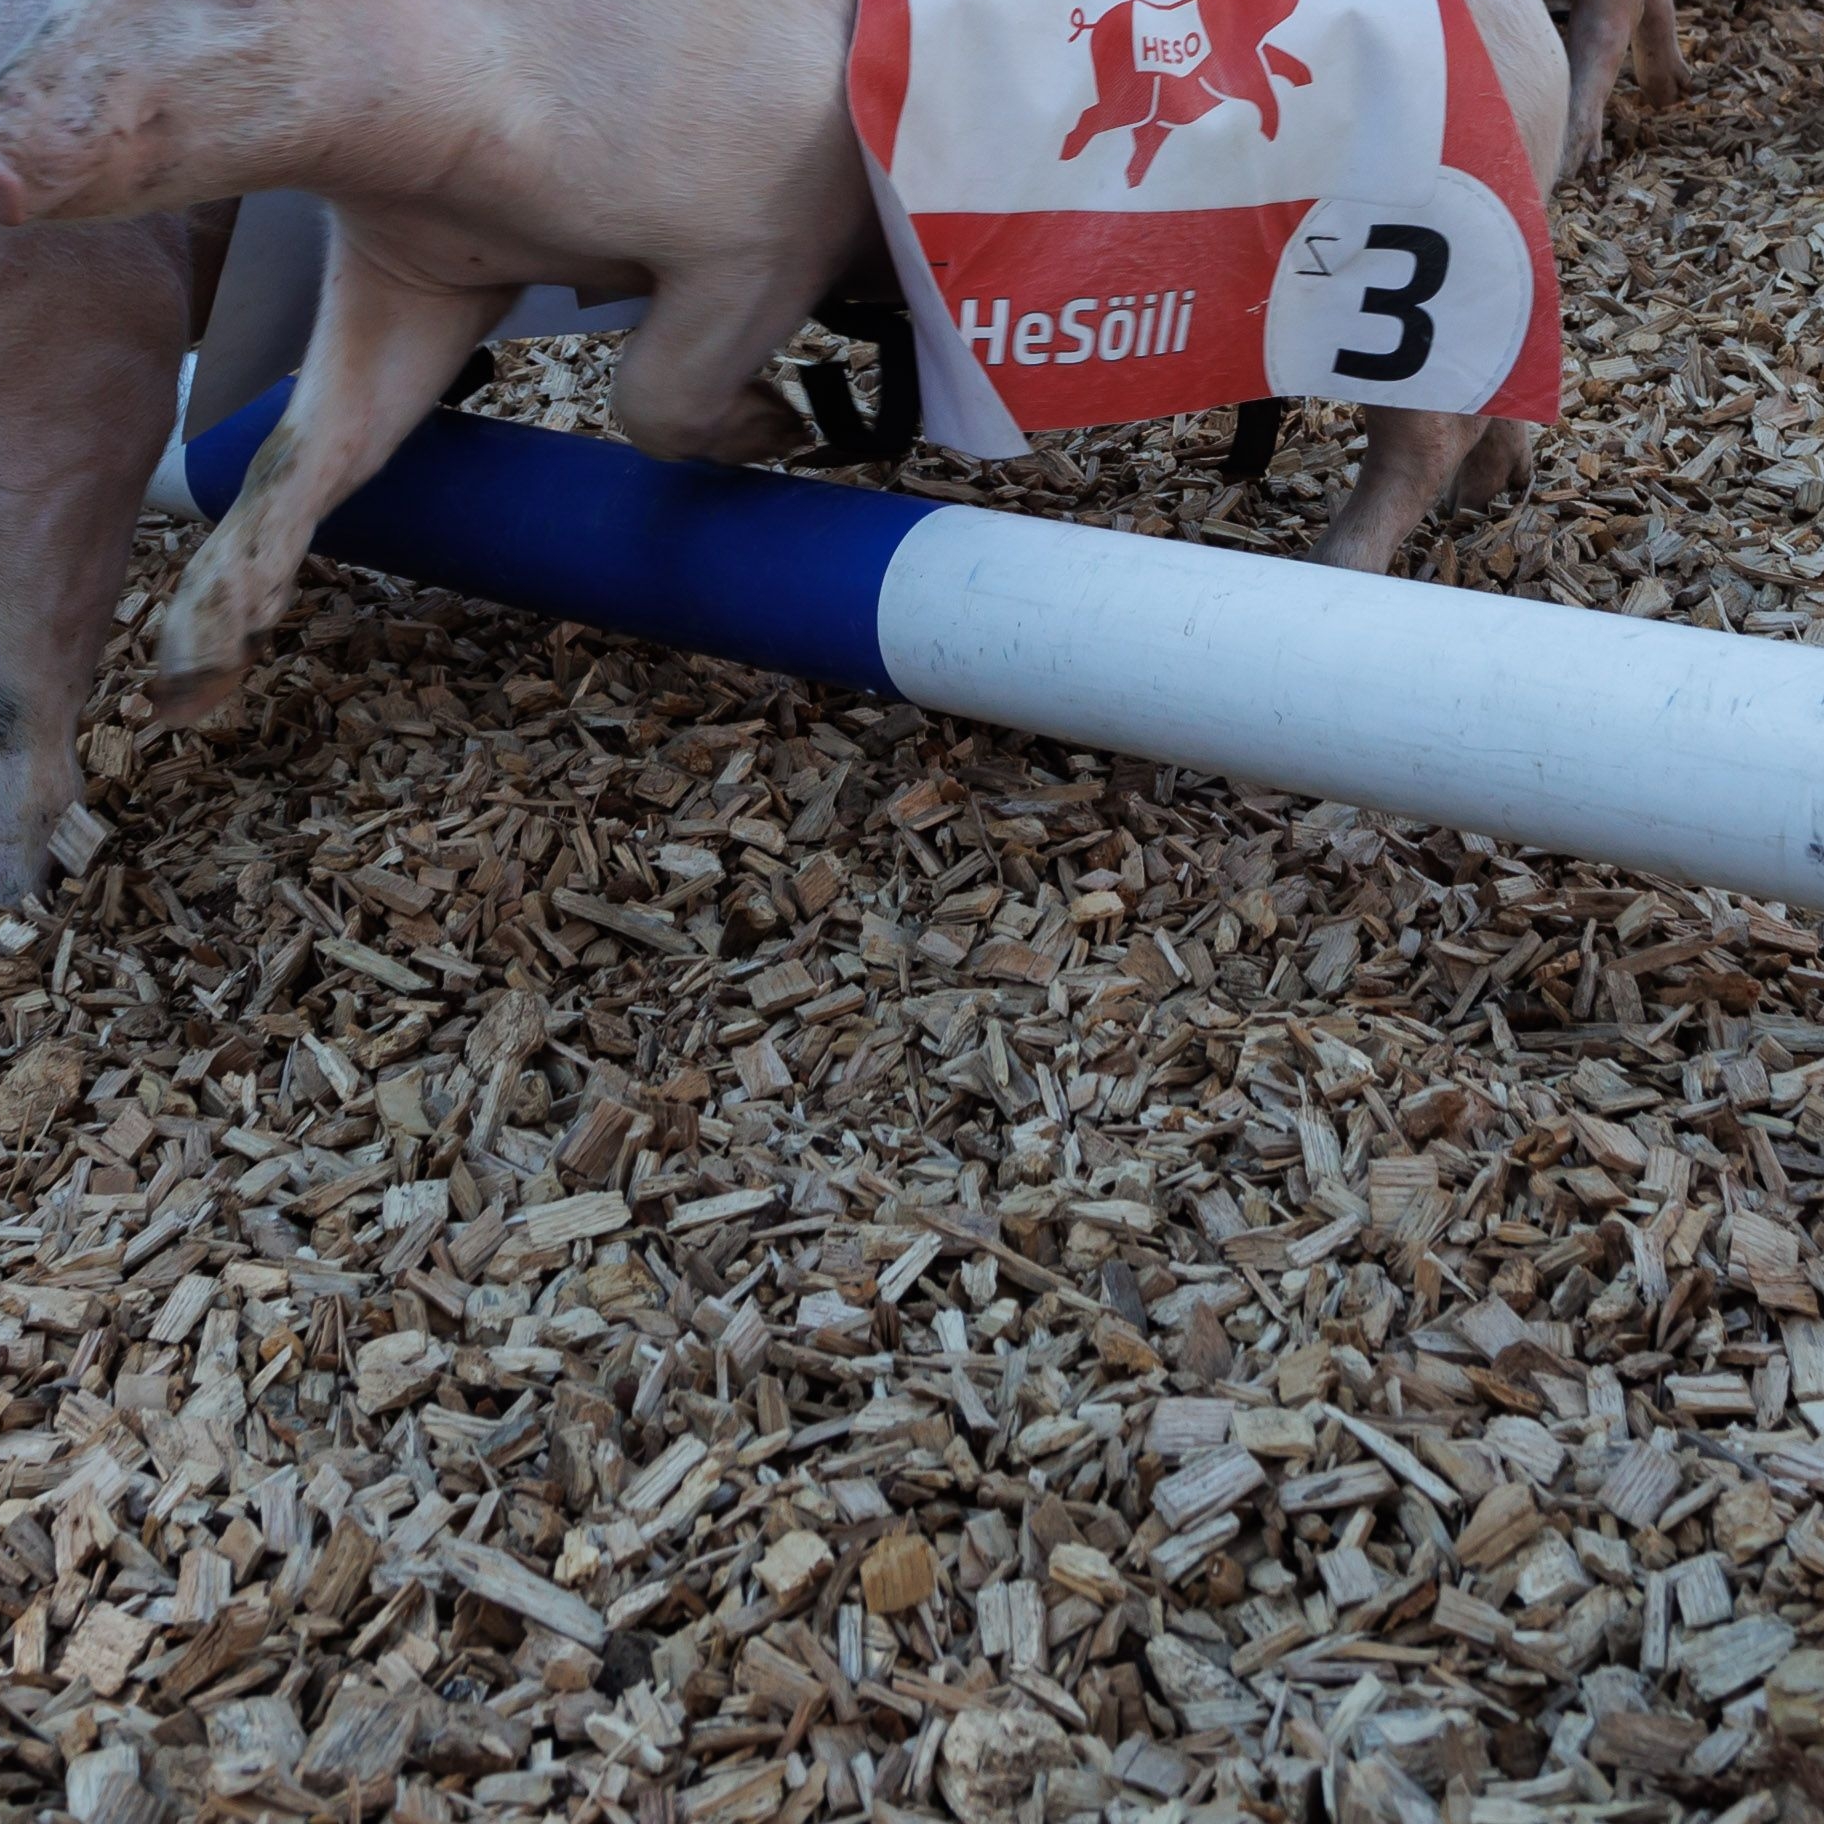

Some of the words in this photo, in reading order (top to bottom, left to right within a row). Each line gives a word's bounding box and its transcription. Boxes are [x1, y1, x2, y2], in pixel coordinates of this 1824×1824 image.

[1141, 31, 1201, 65] HESO
[959, 289, 1197, 367] HeSöili
[1331, 223, 1451, 382] 3
